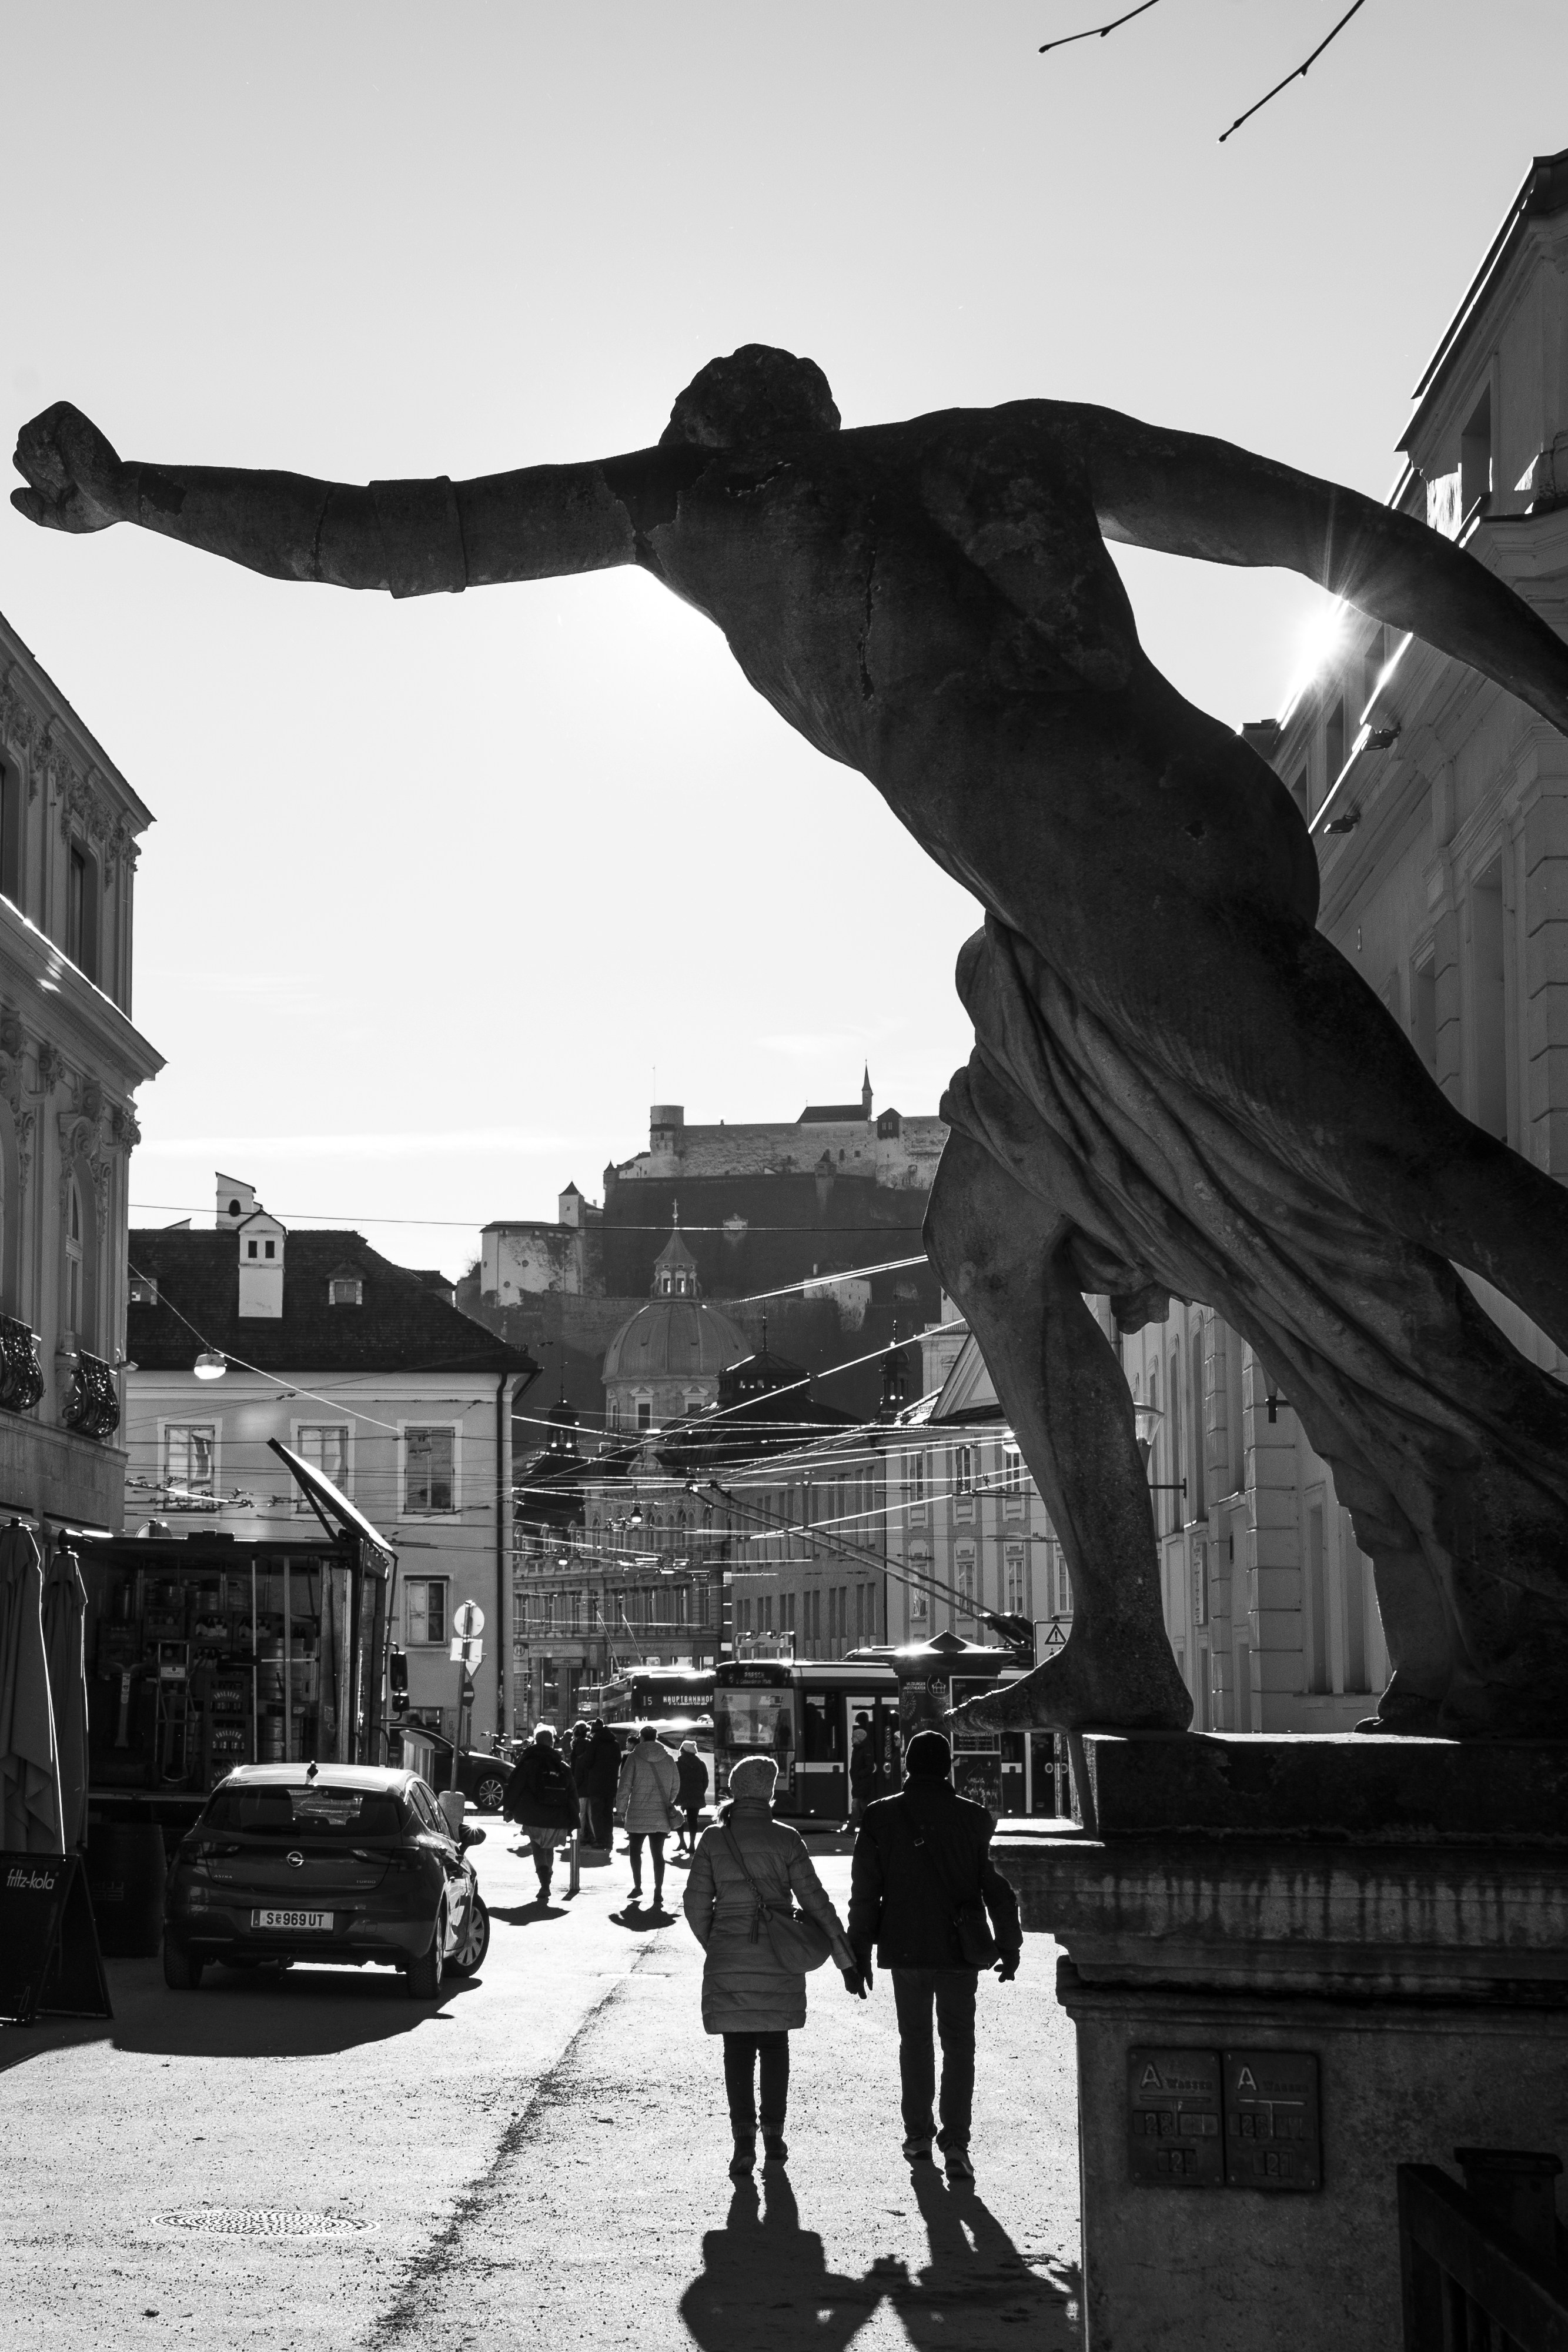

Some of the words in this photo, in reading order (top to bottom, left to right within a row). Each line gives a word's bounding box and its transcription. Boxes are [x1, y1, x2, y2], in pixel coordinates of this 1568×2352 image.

[647, 1696, 653, 1705] 5
[6, 1868, 55, 1890] fritz-kola
[1141, 2062, 1162, 2089] A
[1237, 2064, 1258, 2092] A
